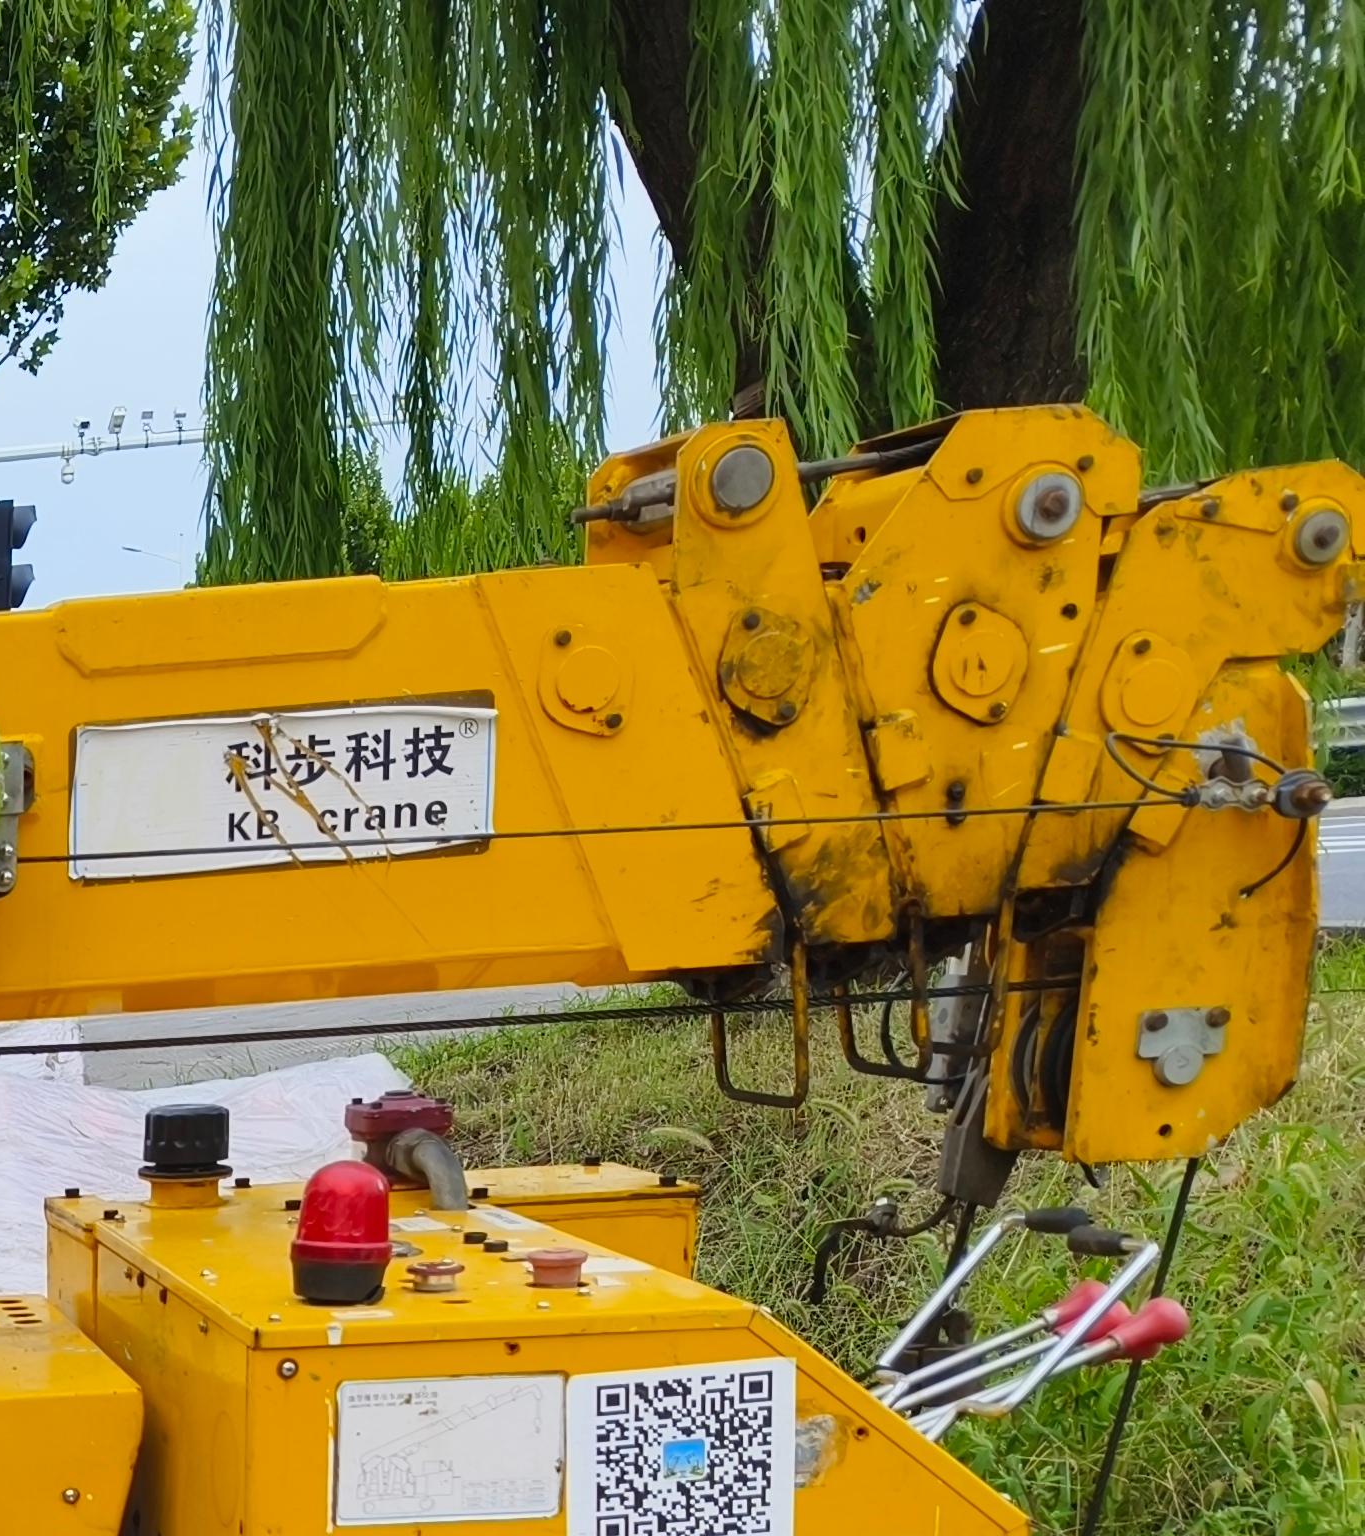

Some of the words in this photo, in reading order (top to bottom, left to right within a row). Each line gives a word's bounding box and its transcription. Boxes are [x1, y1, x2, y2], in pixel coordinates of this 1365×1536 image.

[226, 725, 455, 792] 科步科技
[227, 809, 280, 843] KB
[317, 799, 448, 835] crane
